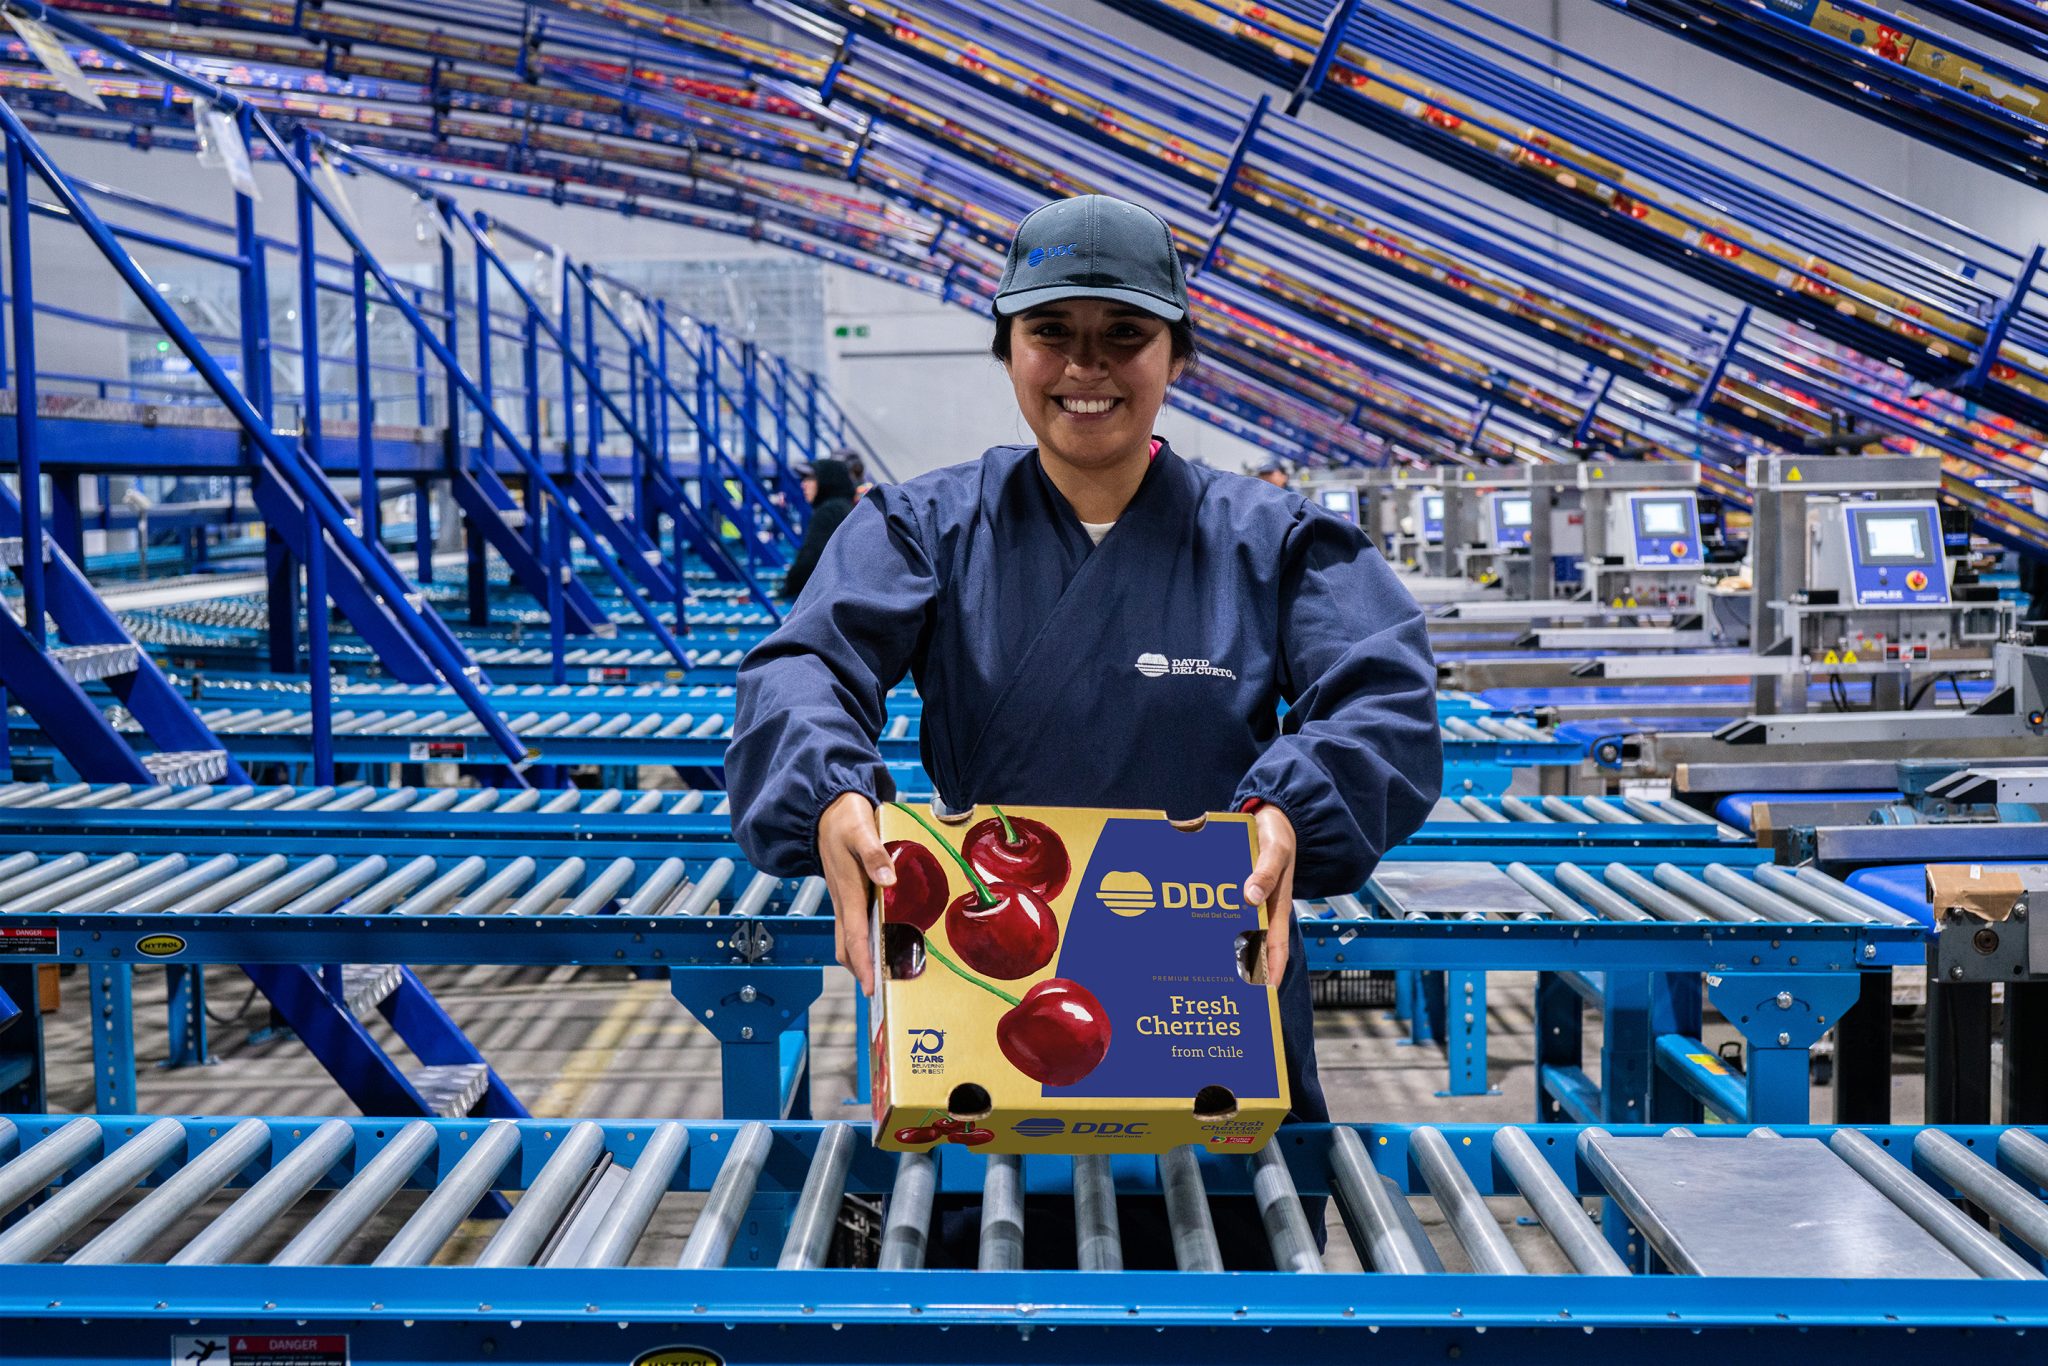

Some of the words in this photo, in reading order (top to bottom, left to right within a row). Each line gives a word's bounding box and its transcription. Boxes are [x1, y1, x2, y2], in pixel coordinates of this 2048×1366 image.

[1048, 242, 1077, 257] DDC
[1171, 658, 1210, 667] DAVID
[1171, 666, 1195, 675] DEL
[1161, 882, 1240, 910] DDC
[1191, 911, 1210, 919] David
[1211, 911, 1223, 919] Del
[1169, 995, 1240, 1015] Fresh
[1136, 1015, 1241, 1036] Cherries
[1171, 1045, 1205, 1058] from
[1207, 1045, 1244, 1058] Chile
[910, 1055, 944, 1063] YEARS
[1071, 1122, 1150, 1135] DDC
[268, 1339, 318, 1351] DANGER
